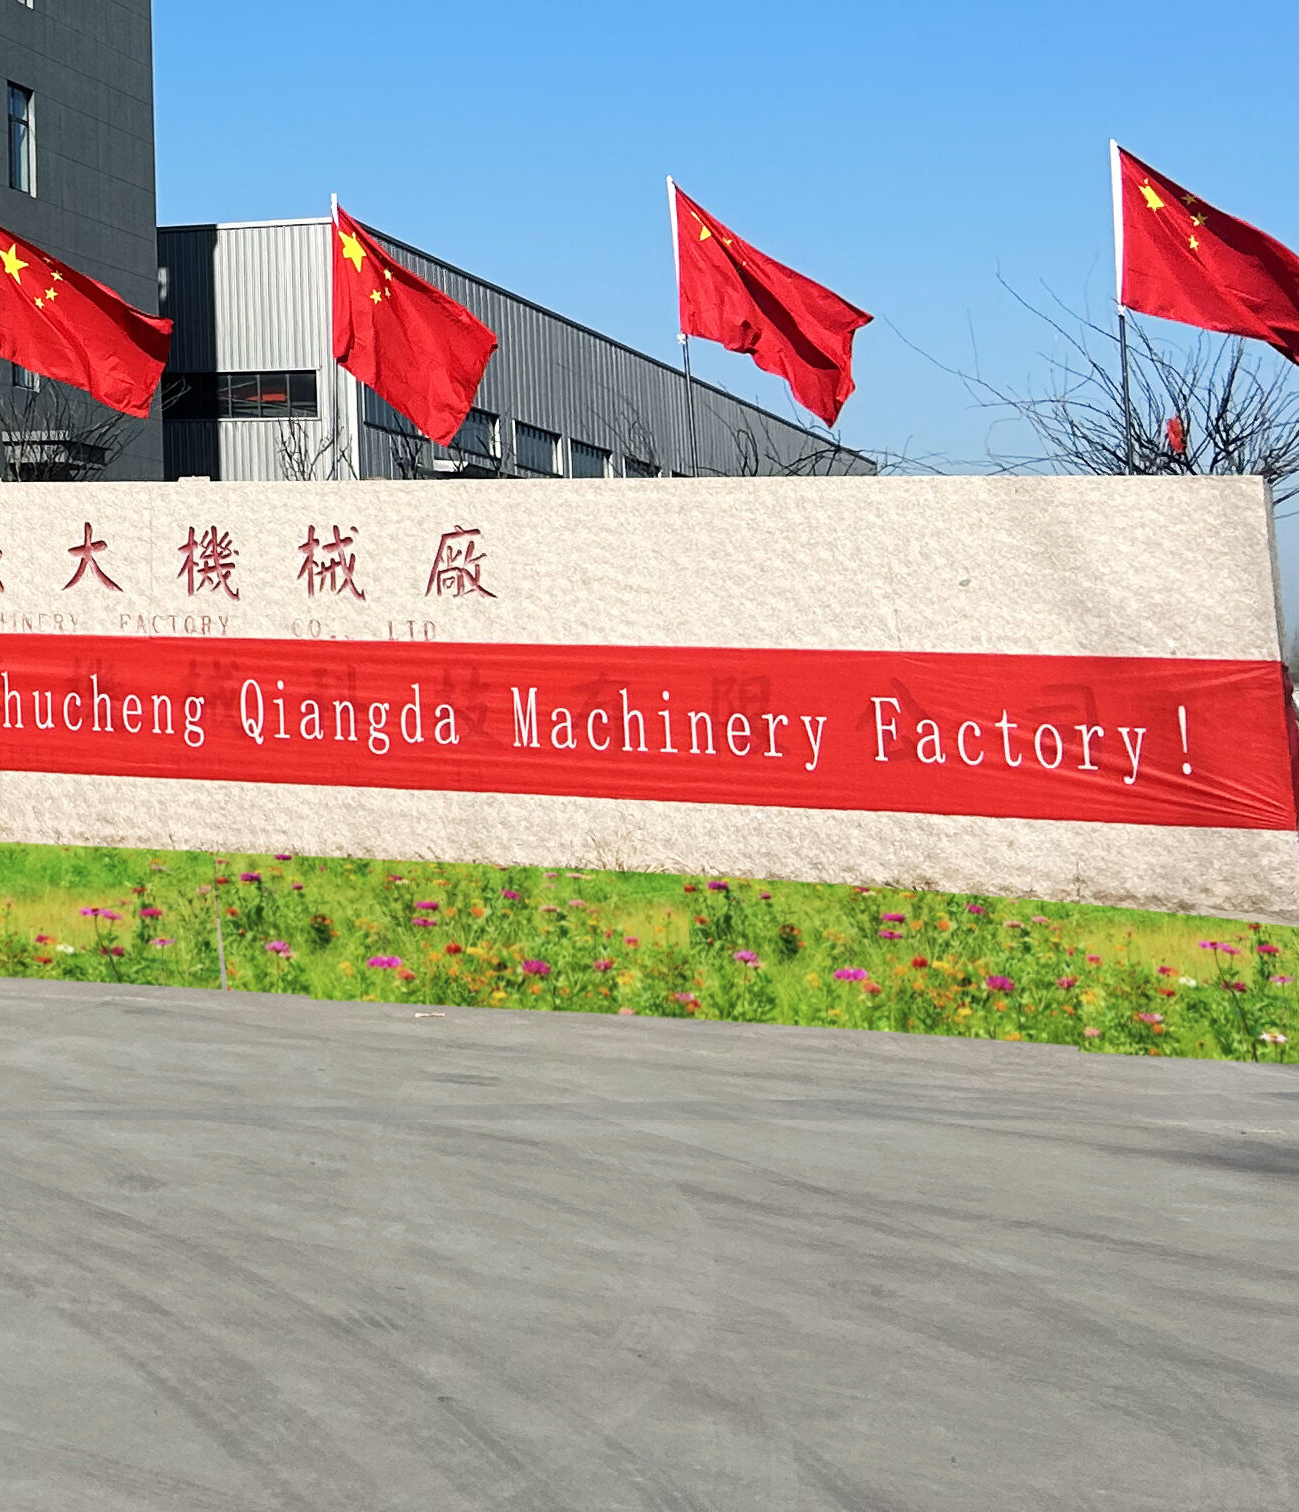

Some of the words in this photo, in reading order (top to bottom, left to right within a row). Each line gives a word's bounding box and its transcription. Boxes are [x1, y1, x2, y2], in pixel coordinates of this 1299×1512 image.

[119, 613, 230, 636] FACTORY
[240, 679, 460, 755] Qiangda
[511, 686, 827, 771] Machinery
